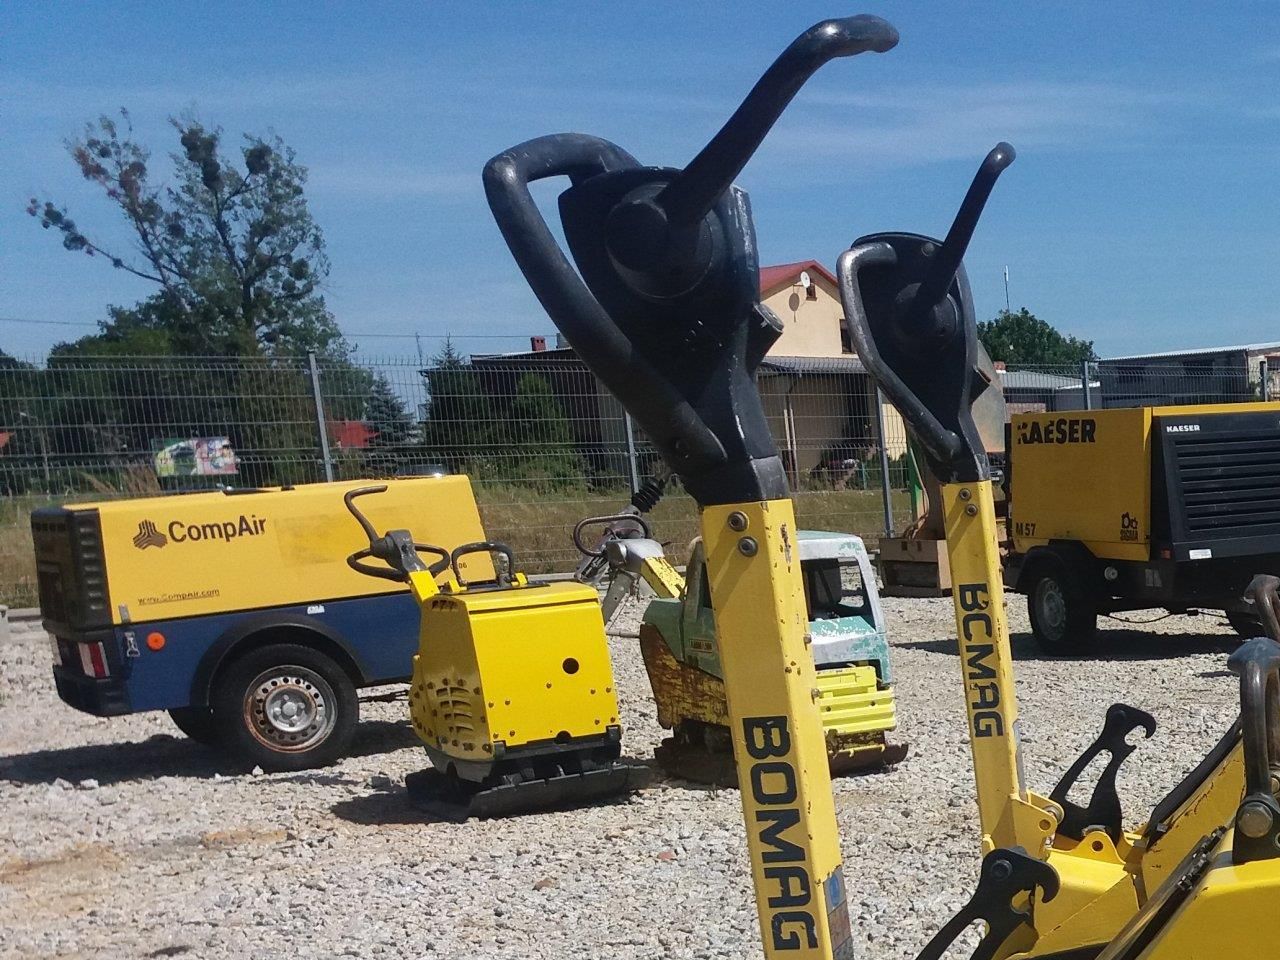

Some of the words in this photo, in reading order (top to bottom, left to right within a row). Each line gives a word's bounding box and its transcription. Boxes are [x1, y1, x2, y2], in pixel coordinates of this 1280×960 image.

[1166, 424, 1200, 433] KAESER
[168, 514, 267, 543] CompAir
[742, 715, 819, 951] BOMAG
